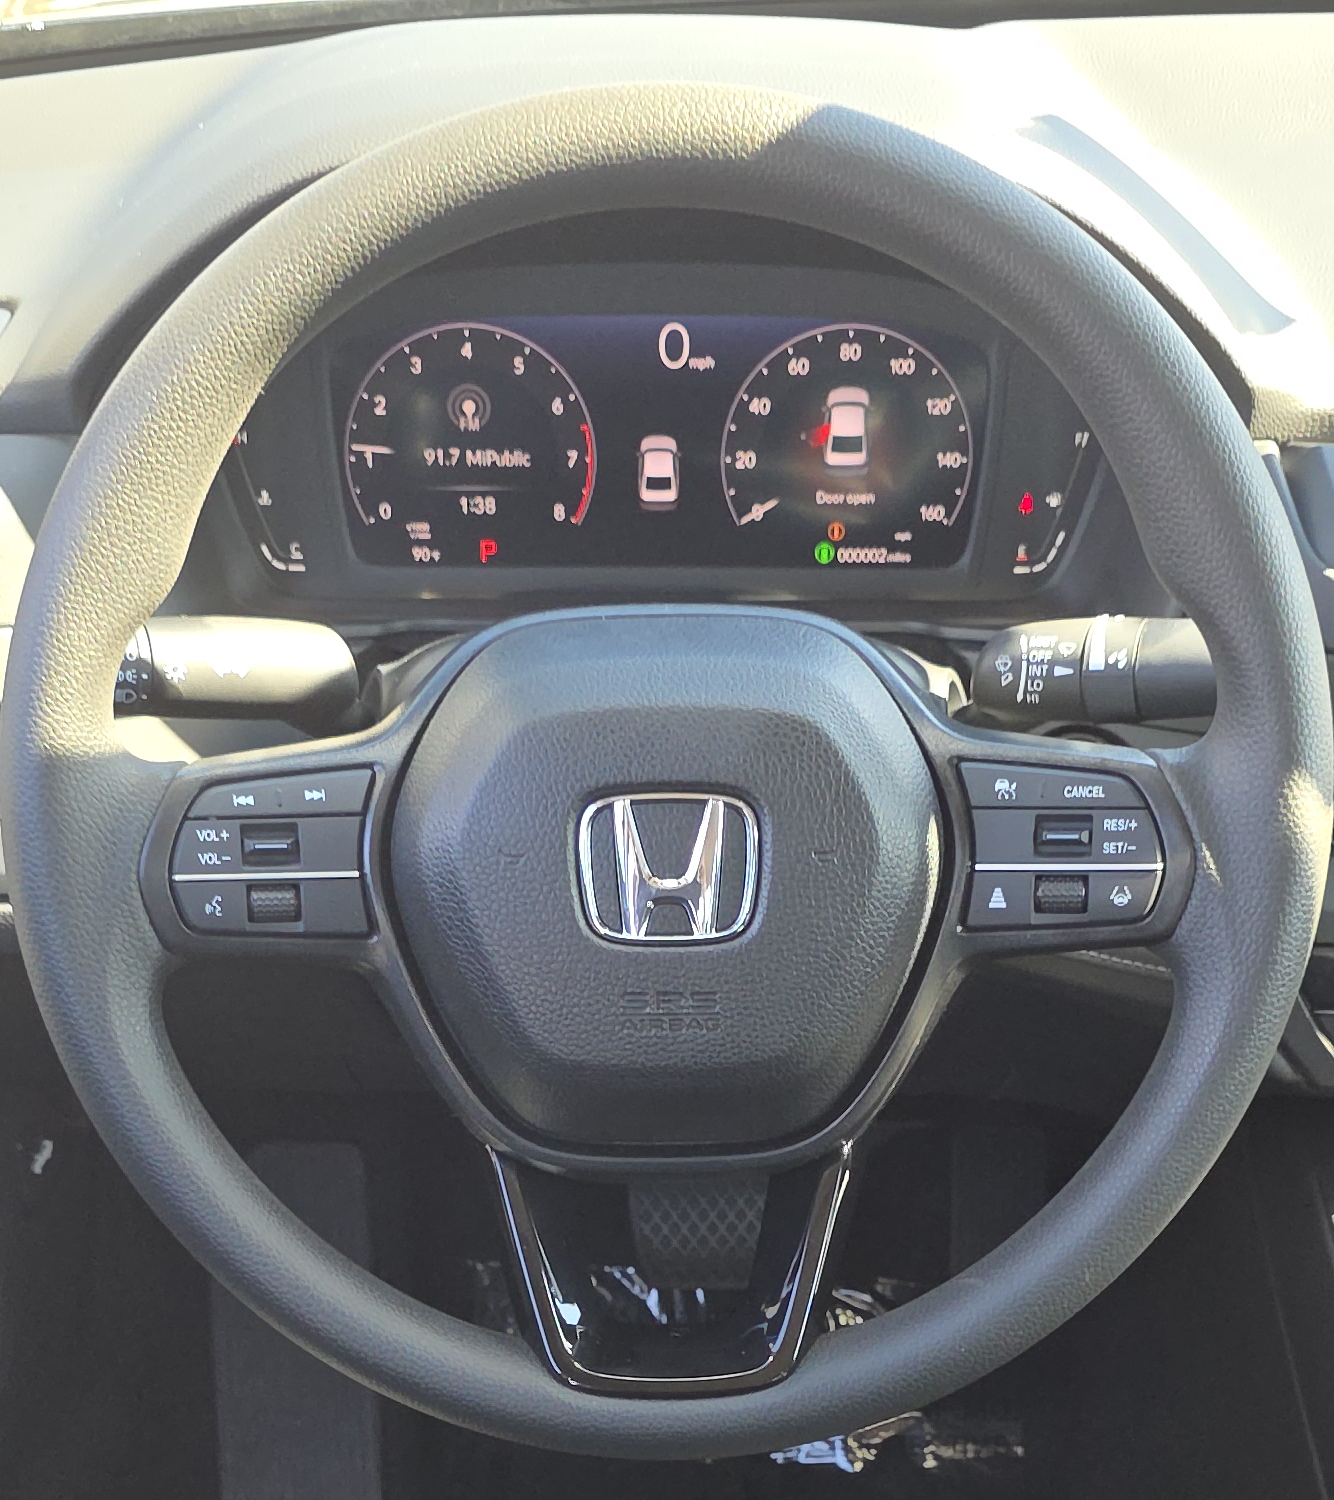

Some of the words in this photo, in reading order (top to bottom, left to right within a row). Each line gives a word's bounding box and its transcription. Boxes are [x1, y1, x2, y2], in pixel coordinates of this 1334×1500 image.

[461, 341, 473, 360] 4
[659, 322, 690, 370] 0
[839, 342, 862, 361] 80
[410, 355, 422, 374] 3
[513, 355, 525, 375] 5
[787, 357, 810, 376] 60
[889, 358, 916, 376] 100
[373, 394, 386, 416] 2
[551, 395, 564, 416] 6
[749, 397, 771, 416] 40
[926, 397, 951, 416] 120
[423, 447, 460, 467] 91.7
[567, 449, 578, 468] 7
[735, 450, 757, 470] 20
[936, 451, 961, 469] 140
[459, 496, 497, 515] 1:38
[816, 490, 845, 505] Door
[846, 492, 875, 507] open
[379, 502, 392, 520] 0
[553, 502, 566, 522] 8
[920, 504, 945, 522] 160
[480, 539, 498, 563] P
[837, 546, 888, 564] 000002
[1029, 650, 1053, 663] OFF
[1029, 664, 1048, 677] INT
[1028, 679, 1043, 691] LO
[1064, 785, 1105, 799] CANCEL
[1103, 818, 1138, 832] RES/+
